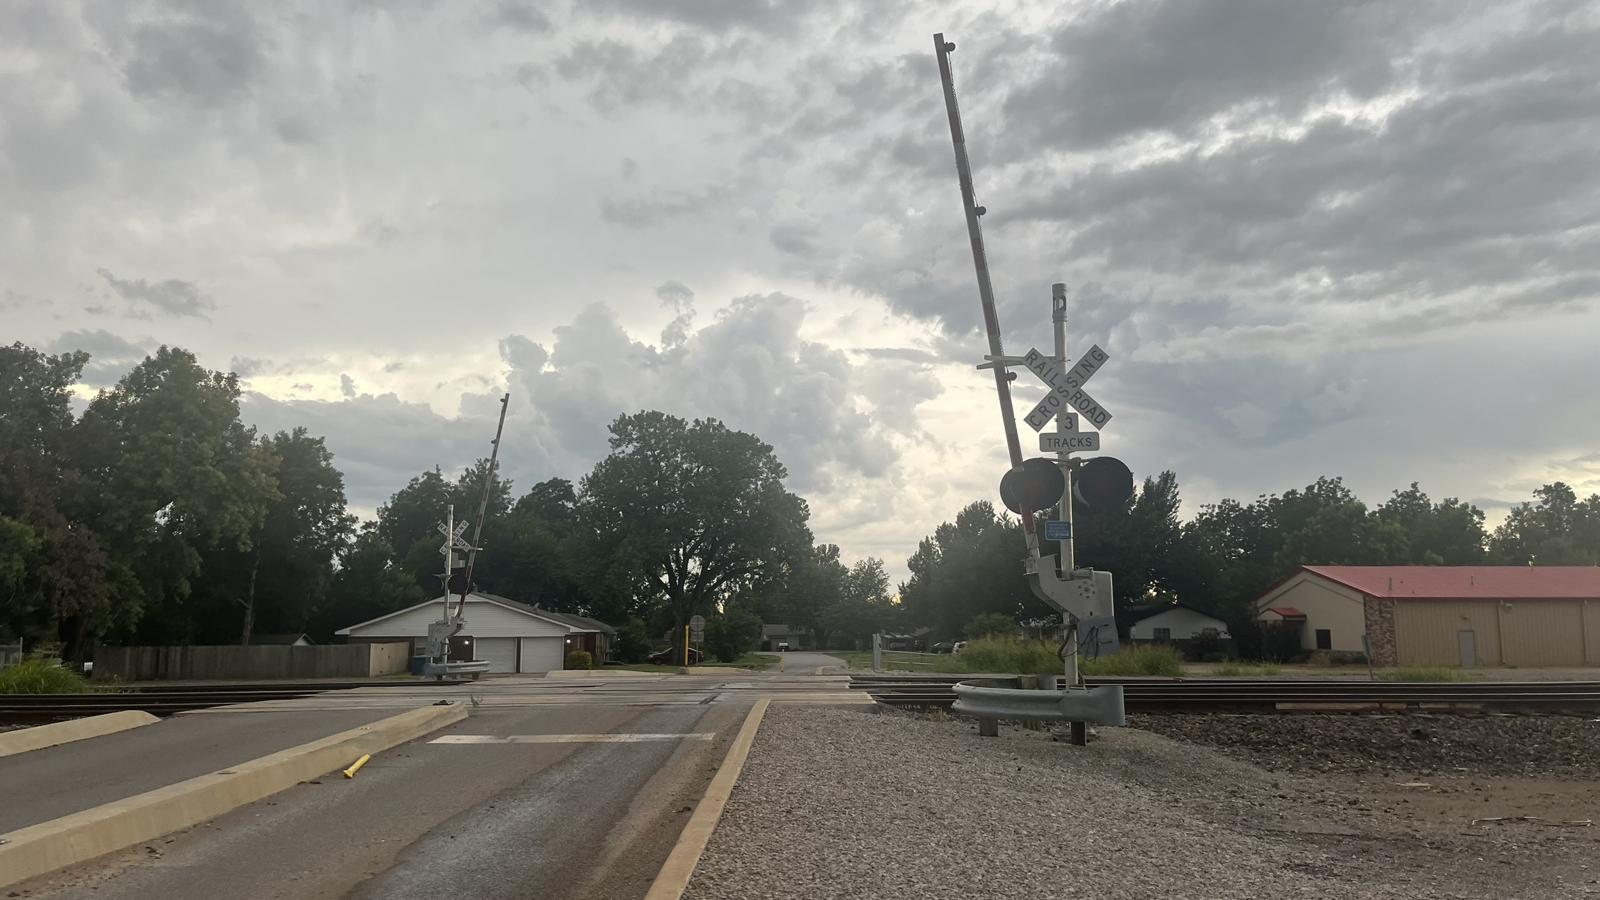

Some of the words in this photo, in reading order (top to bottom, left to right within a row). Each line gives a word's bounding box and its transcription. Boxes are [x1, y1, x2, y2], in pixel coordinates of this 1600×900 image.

[1029, 349, 1104, 427] CROSSING
[1064, 416, 1073, 430] 3
[1046, 437, 1092, 448] TRACKS
